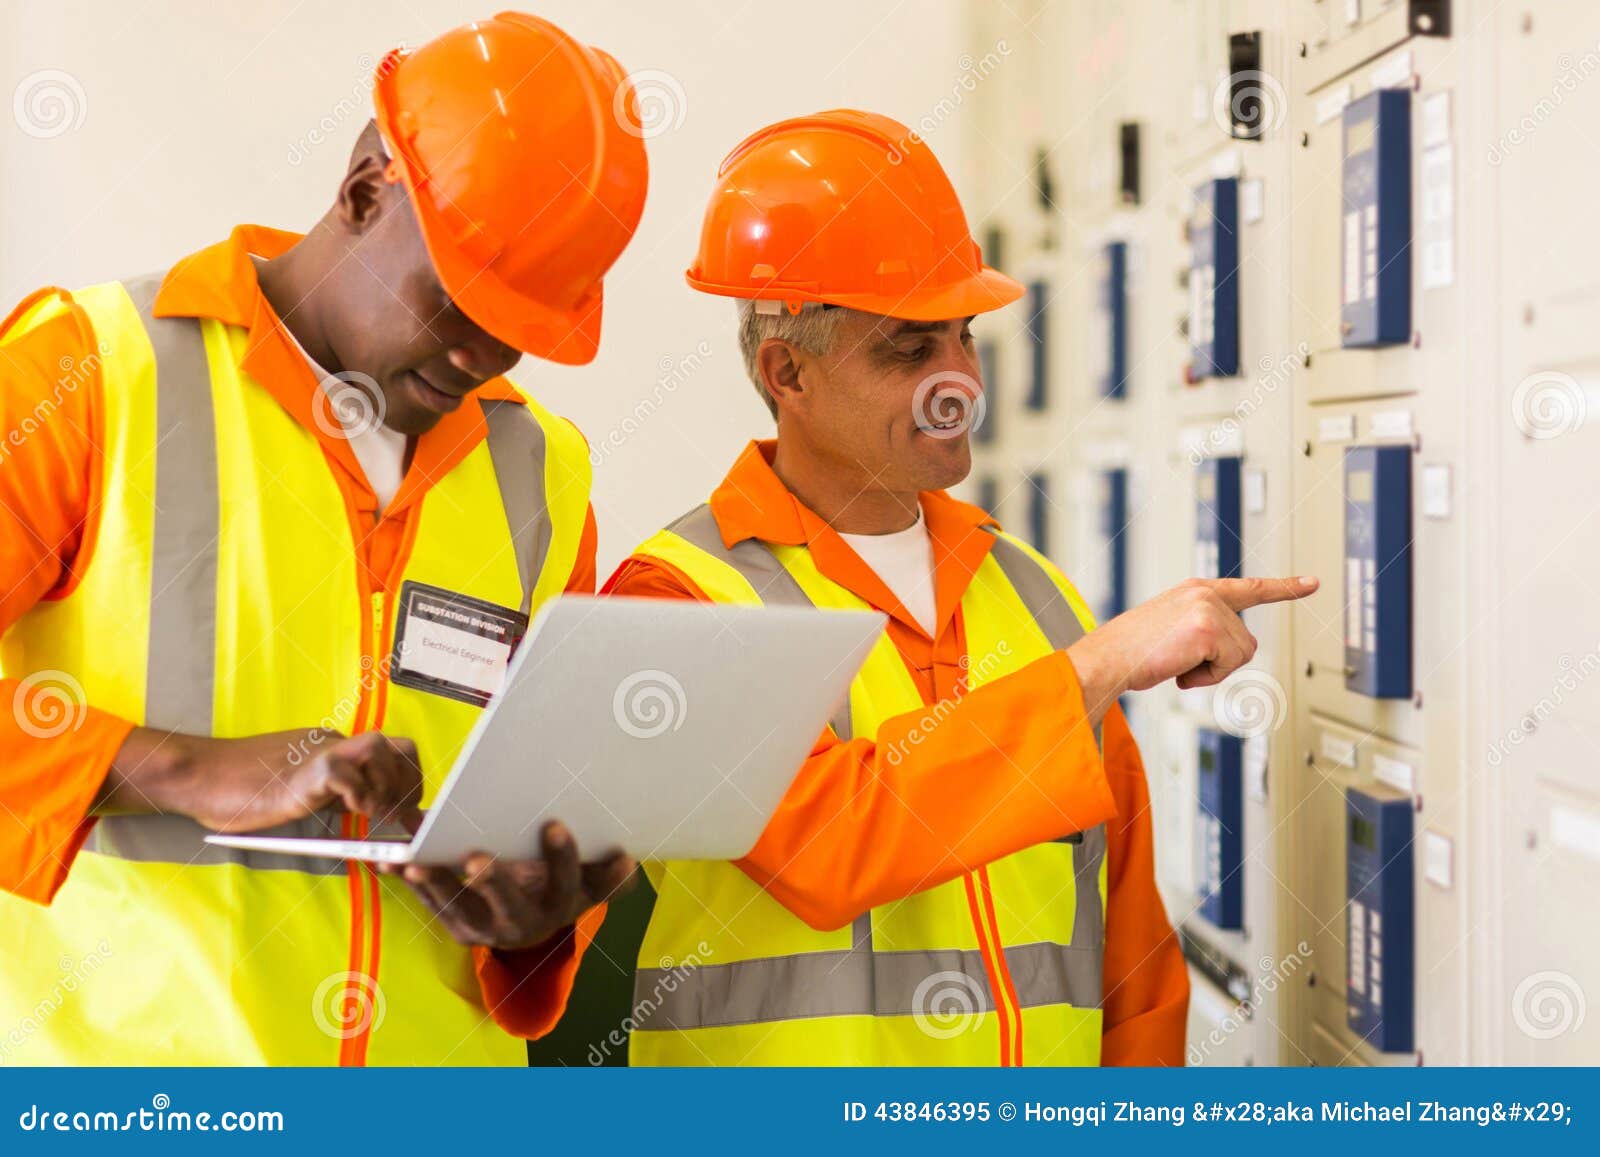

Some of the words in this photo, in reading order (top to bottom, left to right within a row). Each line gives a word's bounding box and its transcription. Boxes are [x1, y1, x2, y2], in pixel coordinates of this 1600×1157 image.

[417, 602, 470, 624] SUBSTATION
[471, 617, 506, 635] DIVISION
[422, 637, 460, 655] Electrical
[460, 648, 497, 666] Engineer
